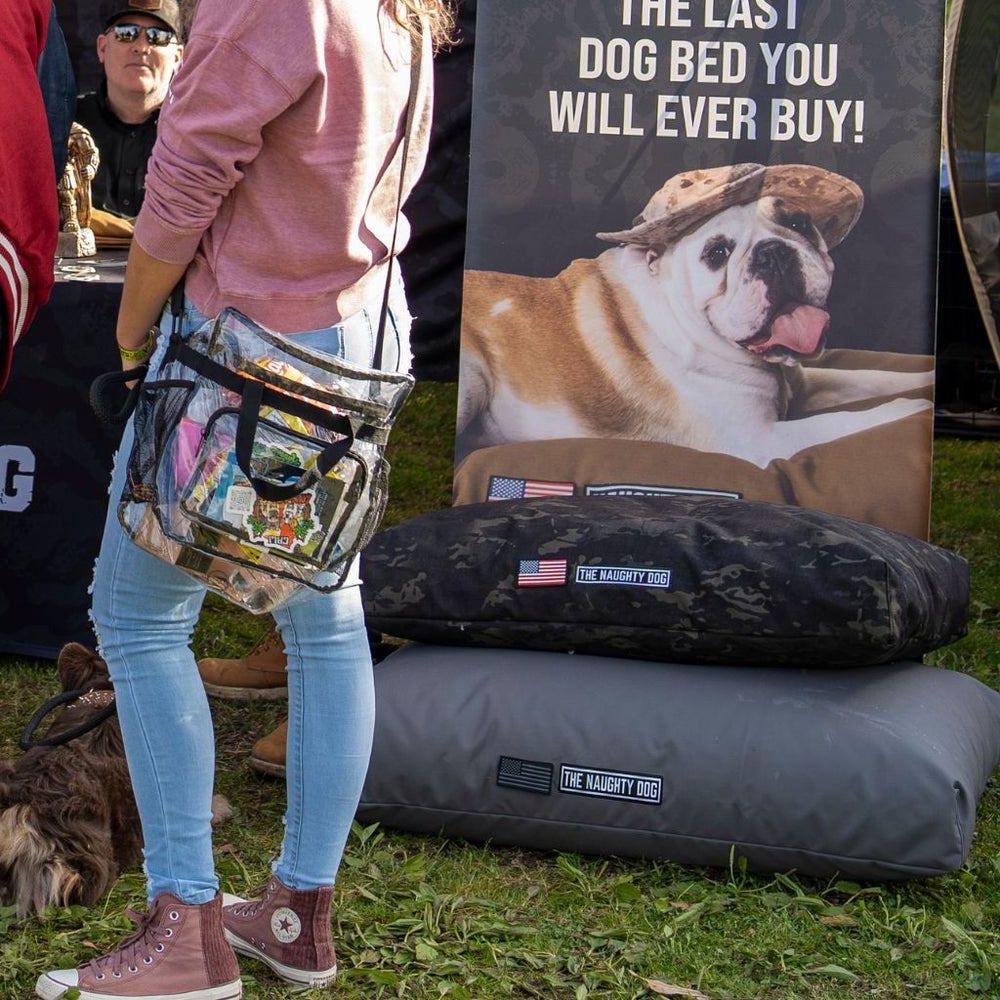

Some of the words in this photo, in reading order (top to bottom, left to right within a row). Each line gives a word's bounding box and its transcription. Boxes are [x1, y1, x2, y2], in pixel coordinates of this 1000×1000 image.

[579, 37, 656, 82] DOG
[670, 39, 747, 84] BED
[759, 42, 838, 87] YOU
[549, 90, 644, 137] WILL
[656, 94, 757, 141] EVER
[771, 98, 865, 144] BUY!
[580, 569, 598, 580] THE
[600, 570, 645, 582] NAUGHTY
[647, 572, 667, 584] DOG
[564, 771, 583, 788] THE
[585, 774, 634, 795] NAUGHTY
[636, 781, 658, 798] DOG
